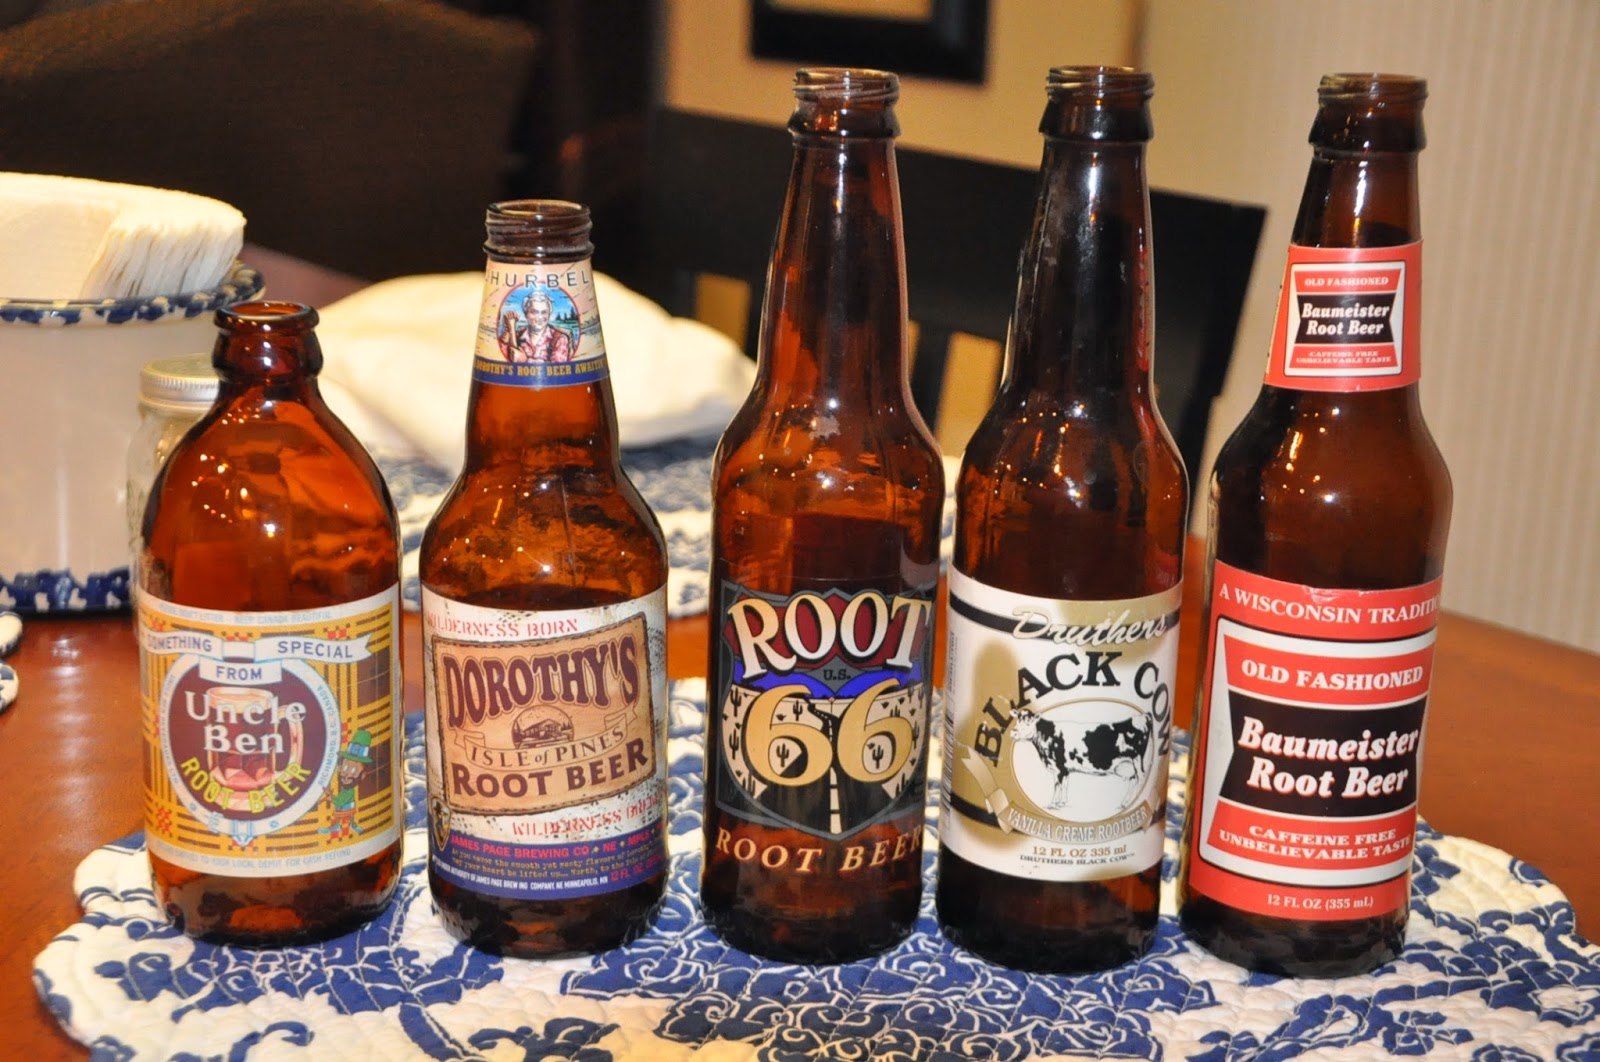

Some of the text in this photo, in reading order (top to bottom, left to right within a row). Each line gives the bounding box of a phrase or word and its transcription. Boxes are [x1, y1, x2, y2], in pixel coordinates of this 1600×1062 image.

[1304, 276, 1389, 287] OLD FASHIONED
[1302, 302, 1390, 319] Baumeister
[1306, 319, 1384, 336] Root Beer
[517, 366, 542, 377] ROOT
[547, 364, 571, 377] BEER
[1219, 582, 1231, 600] A
[1234, 587, 1362, 624] WISCONSIN
[527, 618, 578, 637] BORN
[727, 591, 932, 680] ROOT
[1011, 605, 1168, 648] Druthers
[278, 640, 353, 659] SPECIAL
[216, 665, 262, 682] FROM
[441, 634, 640, 728] DOROTHY'S
[823, 668, 851, 681] U.S.
[1241, 659, 1424, 691] OLD FASHIONED
[185, 690, 307, 726] Uncle
[974, 650, 1123, 768] BLACK
[1134, 661, 1171, 757] COW
[203, 724, 285, 754] Ben
[745, 677, 914, 787] 66
[1238, 715, 1420, 762] Baumeister
[470, 728, 625, 768] ISLE of PINES
[451, 737, 648, 798] ROOT BEER
[1247, 756, 1409, 798] Root Beer
[181, 757, 311, 814] ROOT BEER
[512, 809, 622, 836] WILDERNESS
[1007, 808, 1052, 838] VANILLA
[1055, 824, 1097, 842] CREME
[1248, 825, 1396, 846] CAFFEINE FREE
[451, 834, 480, 852] JAMES
[483, 843, 511, 858] PAGE
[514, 847, 569, 860] BREWING
[573, 845, 590, 857] CO
[603, 841, 617, 853] NE
[715, 825, 923, 873] ROOT BEER
[1032, 845, 1047, 857] 12
[1050, 847, 1067, 858] FL
[1069, 848, 1087, 858] OZ
[1219, 829, 1369, 861] UNBELIEVABLE
[495, 859, 509, 868] the
[511, 861, 540, 869] smooth
[543, 861, 558, 870] yet
[1019, 855, 1074, 866] DRUTHERS
[1076, 857, 1107, 866] BLACK
[476, 874, 491, 886] JAMES
[491, 878, 503, 887] PAGE
[1267, 893, 1280, 906] 12
[1284, 895, 1299, 908] FL
[1303, 898, 1321, 910] OZ
[1325, 898, 1351, 912] (355
